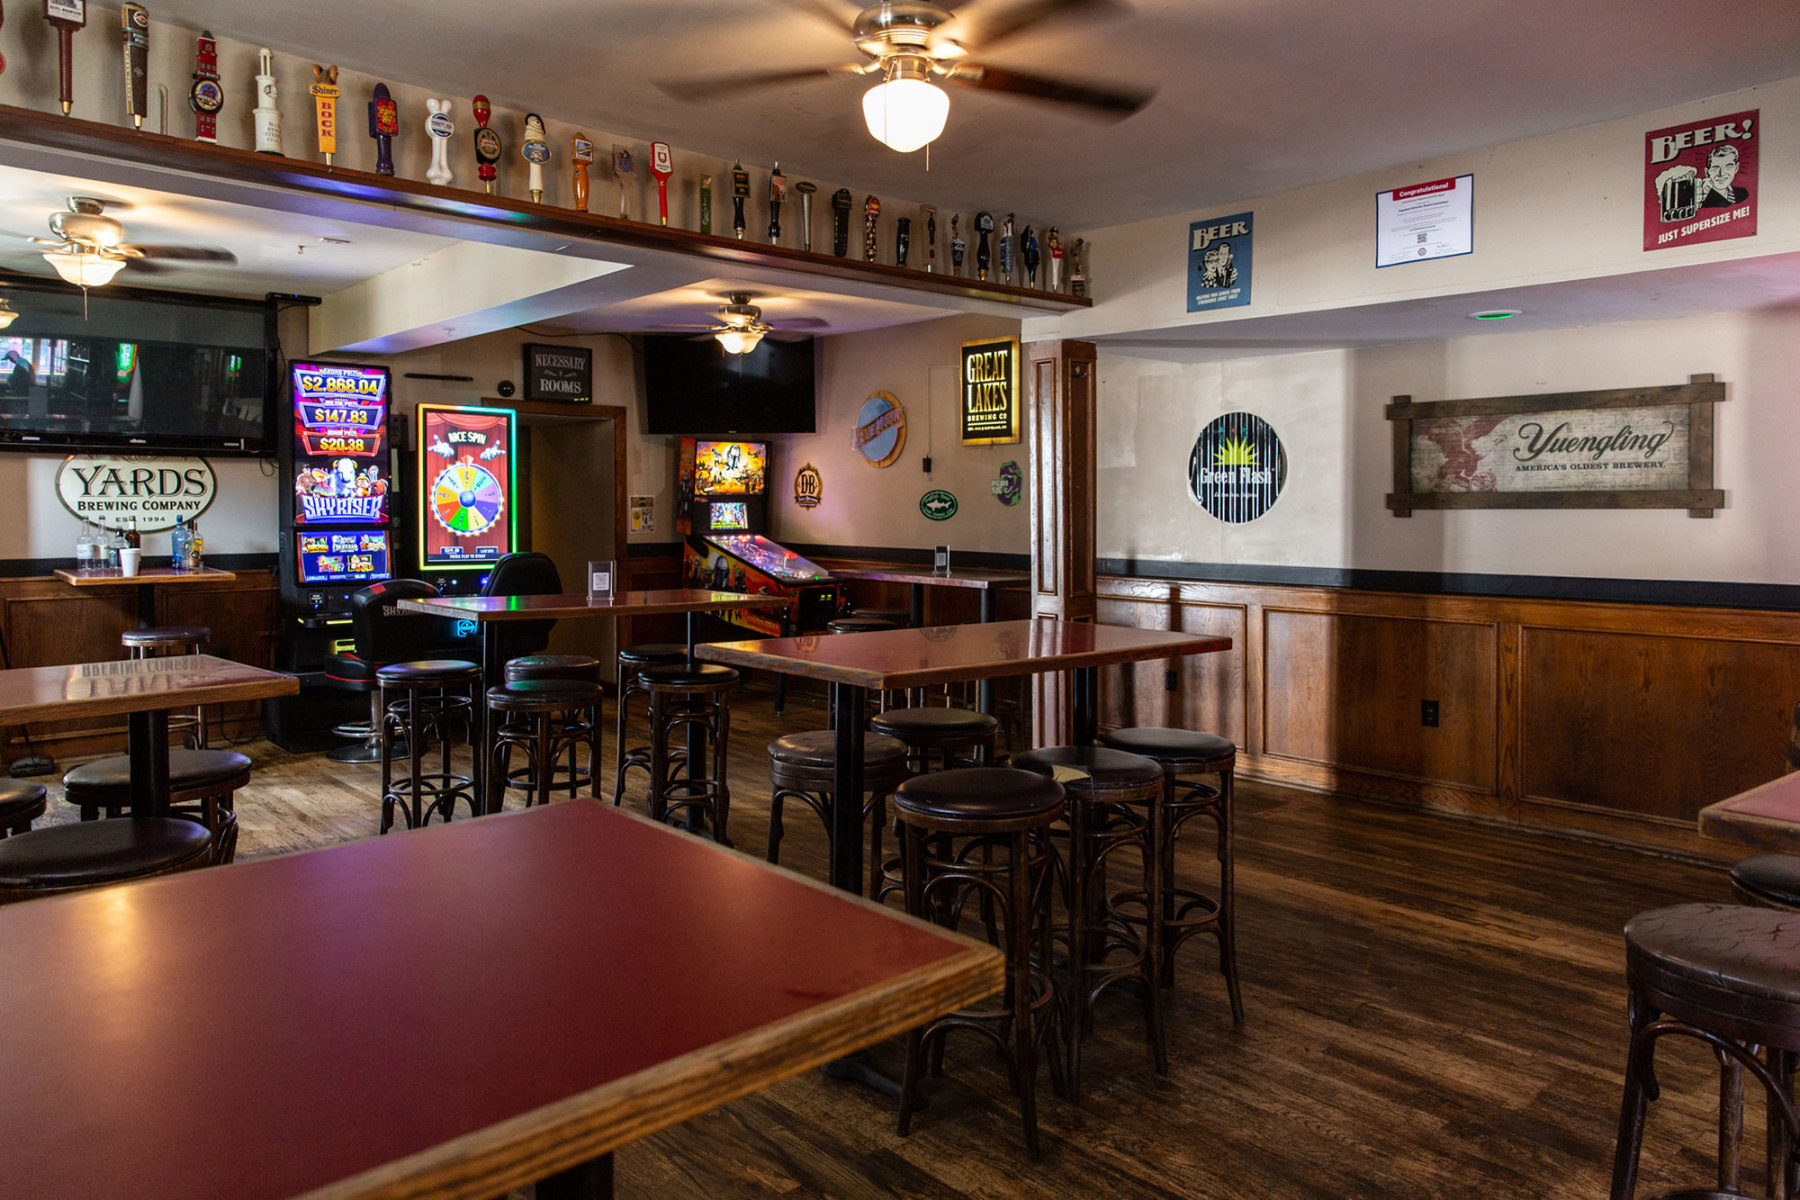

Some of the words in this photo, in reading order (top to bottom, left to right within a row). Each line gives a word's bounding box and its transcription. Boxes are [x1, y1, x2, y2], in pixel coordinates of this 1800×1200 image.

[311, 85, 338, 97] Shiner
[320, 102, 333, 137] BOCK
[1650, 119, 1753, 164] BEER!
[1398, 182, 1449, 198] Congratulations!
[1658, 229, 1679, 245] JUST
[1680, 213, 1731, 238] SUPERSIZE
[1732, 206, 1750, 220] ME!
[1192, 221, 1249, 251] BEER
[535, 353, 586, 370] NECESSARY
[966, 349, 1008, 384] GREAT
[540, 378, 582, 394] ROOMS
[967, 381, 1007, 413] LAKES
[314, 408, 368, 424] $147.83
[967, 413, 997, 422] BREWING
[320, 437, 365, 452] $20.38
[448, 431, 467, 443] NICE
[467, 432, 487, 445] SPIN
[1513, 420, 1675, 462] Yuengling
[1201, 467, 1236, 484] Green
[1239, 467, 1272, 484] Flash
[1515, 464, 1567, 472] AMERICA'S
[1570, 462, 1610, 470] OLDEST
[72, 464, 207, 498] YARDS
[800, 474, 816, 495] DB
[77, 500, 138, 511] BREWING
[142, 500, 202, 511] COMPANY
[302, 495, 382, 519] SKYRISER
